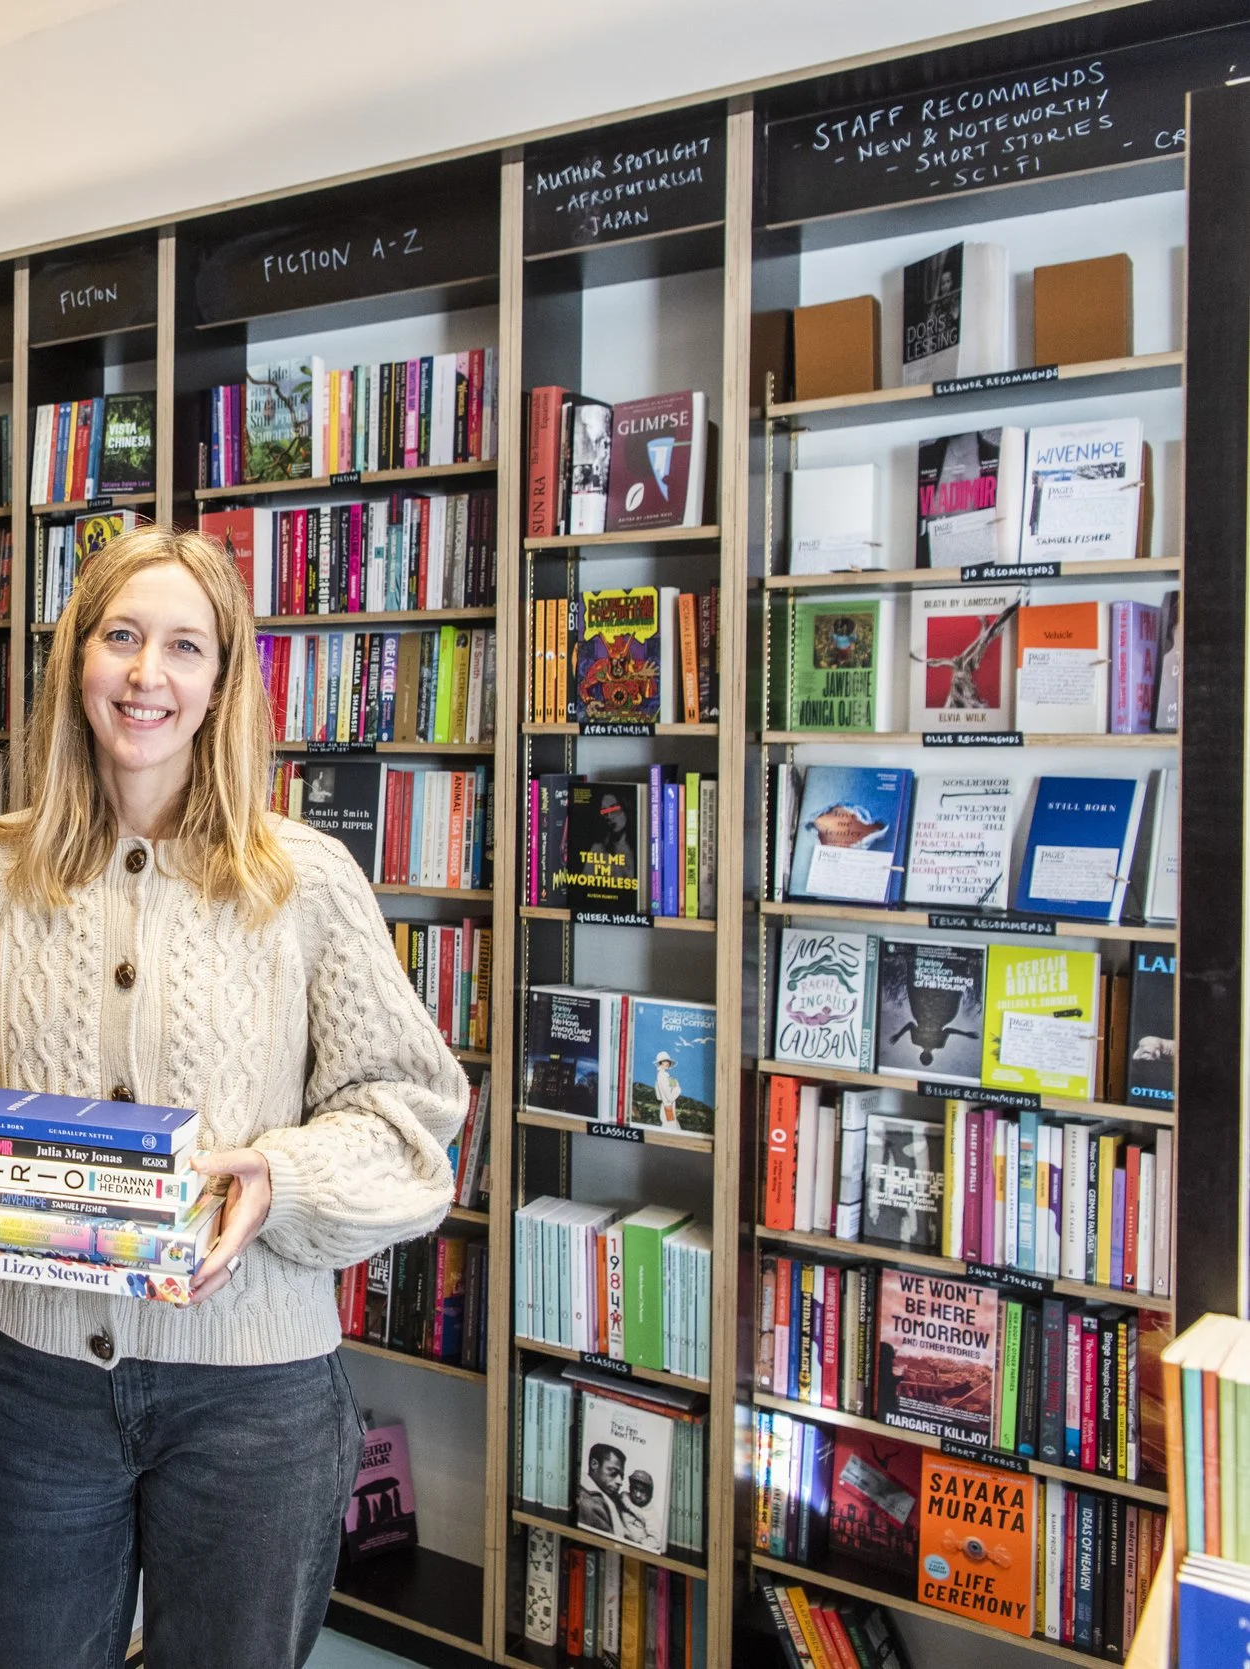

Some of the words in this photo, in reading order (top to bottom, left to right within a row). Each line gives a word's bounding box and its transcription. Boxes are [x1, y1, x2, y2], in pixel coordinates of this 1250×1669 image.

[812, 106, 903, 152] STAFF
[921, 61, 1105, 122] RECOMMENDS
[857, 133, 912, 163] NEW
[922, 130, 937, 147] &
[948, 89, 1109, 143] NOTEWORTHY
[915, 142, 987, 174] SHORT
[1001, 114, 1113, 154] STORIES
[536, 159, 606, 195] AUTHOR
[613, 137, 711, 175] SPOTLIGHT
[953, 155, 1041, 188] SCI-FI
[568, 167, 703, 212] AFROFUTURISM
[590, 206, 650, 236] JAPAN
[264, 241, 351, 282] FICTION
[60, 283, 117, 314] FICTION
[906, 315, 946, 345] DORIS
[906, 327, 958, 361] LESSING
[985, 368, 1058, 389] RECOMMENDS
[108, 423, 137, 436] VISTA
[617, 411, 689, 436] GLIMPSE
[108, 433, 151, 449] CHINESA
[1036, 441, 1125, 465] WIVENHOE
[534, 476, 546, 498] RA
[919, 475, 996, 516] VLADIMIR
[533, 502, 546, 533] SUN
[1035, 536, 1072, 546] SAMUEL
[1074, 533, 1113, 545] FISHER
[982, 565, 1055, 578] RECOMMENDS
[924, 600, 947, 609] DEATH
[1044, 631, 1073, 640] Vehicle
[939, 714, 961, 722] ELVIA
[966, 714, 986, 722] WILK
[584, 725, 650, 735] AFROFUTURISM
[958, 735, 1020, 744] RECOMMENDS
[454, 775, 462, 812] ANIMAL
[309, 809, 339, 817] Amalie
[343, 809, 370, 818] Smith
[1047, 802, 1080, 811] STILL
[1084, 803, 1117, 812] BORN
[342, 821, 374, 830] RIPPER
[915, 831, 984, 840] BAUDELAIRE
[914, 840, 964, 848] FRACTAL
[580, 852, 606, 864] TELL
[608, 854, 625, 866] ME
[594, 865, 611, 876] I'M
[911, 866, 978, 875] ROBERTSON
[566, 875, 639, 891] WORTHLESS
[577, 912, 610, 923] QUEER
[613, 914, 650, 925] HORROR
[1005, 972, 1068, 996] HUNGER
[779, 1020, 857, 1059] CALIBAN
[964, 1089, 1038, 1107] RECOMMENDS
[48, 1128, 87, 1138] GUADALUPE
[88, 1132, 114, 1140] NETTEL
[592, 1127, 639, 1140] CLASSICS
[36, 1145, 62, 1158] Julia
[63, 1148, 89, 1163] May
[90, 1150, 122, 1164] Jonas
[142, 1157, 168, 1168] PICADOR
[97, 1173, 154, 1187] JOHANNA
[99, 1183, 150, 1196] HEDMAN
[1, 1193, 47, 1209] WIVENHOE
[51, 1200, 80, 1211] SAMUEL
[80, 1203, 107, 1214] FISHER
[2, 1258, 45, 1280] Lizzy
[47, 1263, 110, 1286] Stewart
[368, 1267, 389, 1282] LIFE
[1002, 1275, 1044, 1291] STORIES
[900, 1275, 924, 1294] WE
[929, 1281, 983, 1305] WON'T
[905, 1299, 927, 1316] BE
[930, 1304, 976, 1326] HERE
[892, 1316, 990, 1349] TOMORROW
[919, 1341, 945, 1353] OTHER
[946, 1345, 980, 1360] STORIES
[1102, 1332, 1113, 1357] Binge
[584, 1355, 628, 1373] CLASSICS
[886, 1413, 942, 1436] MARGARET
[944, 1422, 988, 1445] KILLJOY
[943, 1443, 975, 1459] SHORT
[981, 1453, 1023, 1471] STORIES
[929, 1472, 1025, 1509] SAYAKA
[928, 1496, 1025, 1533] MURATA
[1082, 1507, 1093, 1534] IDEAS
[1080, 1550, 1093, 1591] HEAVEN
[953, 1571, 996, 1594] LIFE
[924, 1583, 1027, 1619] CEREMONY
